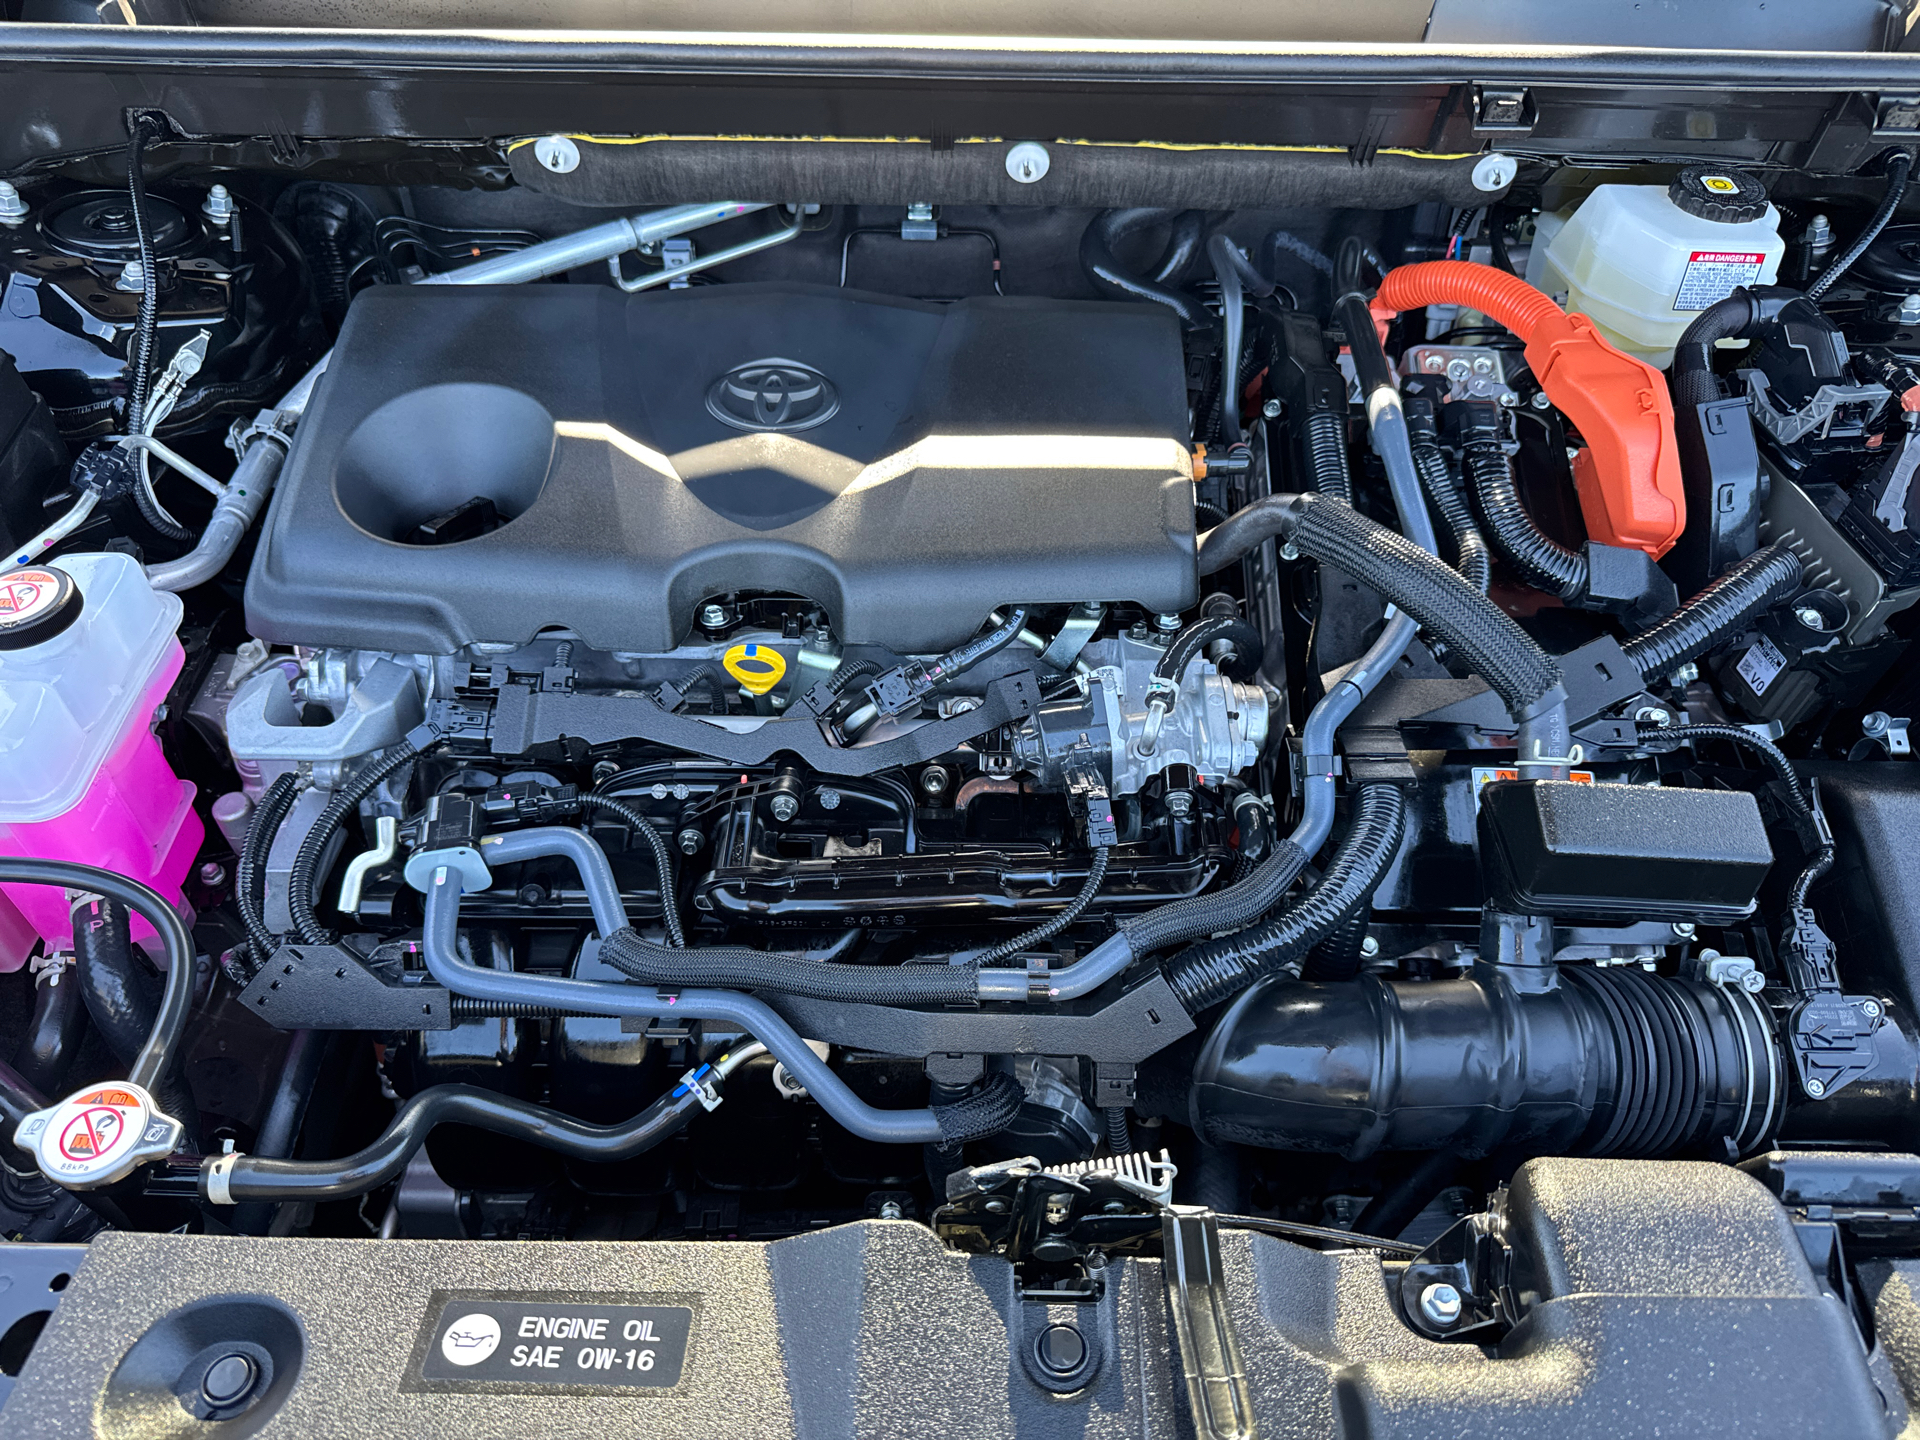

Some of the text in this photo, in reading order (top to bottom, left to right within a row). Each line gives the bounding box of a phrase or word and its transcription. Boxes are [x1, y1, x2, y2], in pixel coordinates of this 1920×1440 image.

[518, 1316, 660, 1342] ENGINE OIL
[510, 1345, 655, 1371] SAE 0W-16
